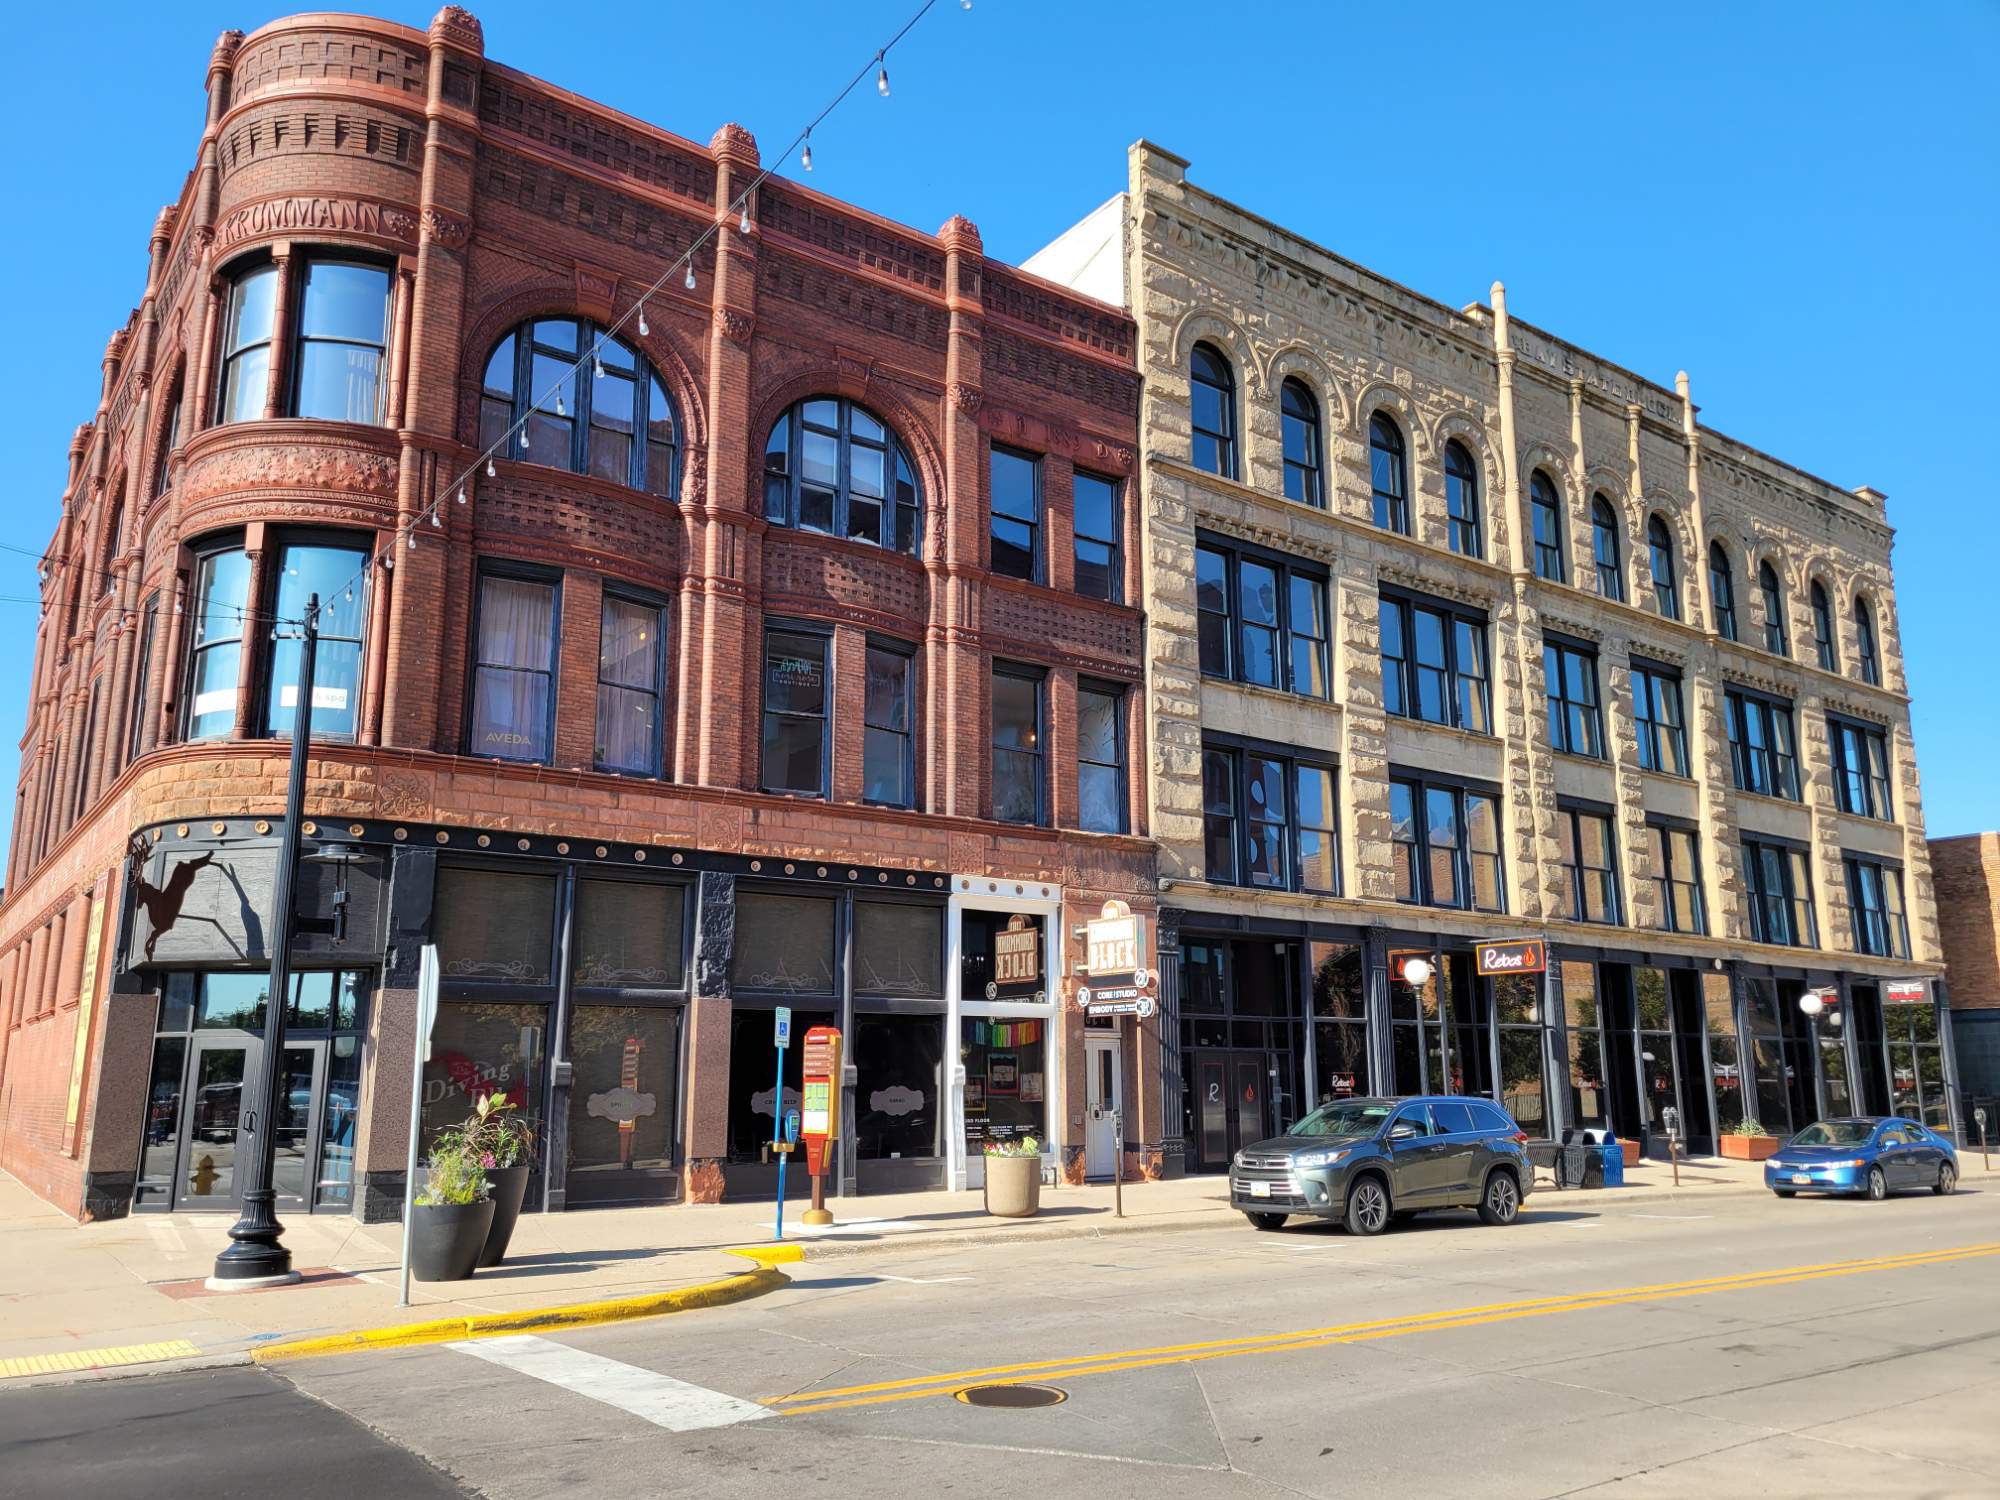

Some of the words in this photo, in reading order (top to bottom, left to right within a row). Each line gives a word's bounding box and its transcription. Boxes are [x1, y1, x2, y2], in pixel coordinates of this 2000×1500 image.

[225, 198, 380, 245] KRUMMANN
[486, 731, 531, 745] AVEDA
[1485, 949, 1522, 969] Rebos
[422, 1063, 512, 1104] Diving
[1209, 1083, 1219, 1102] R
